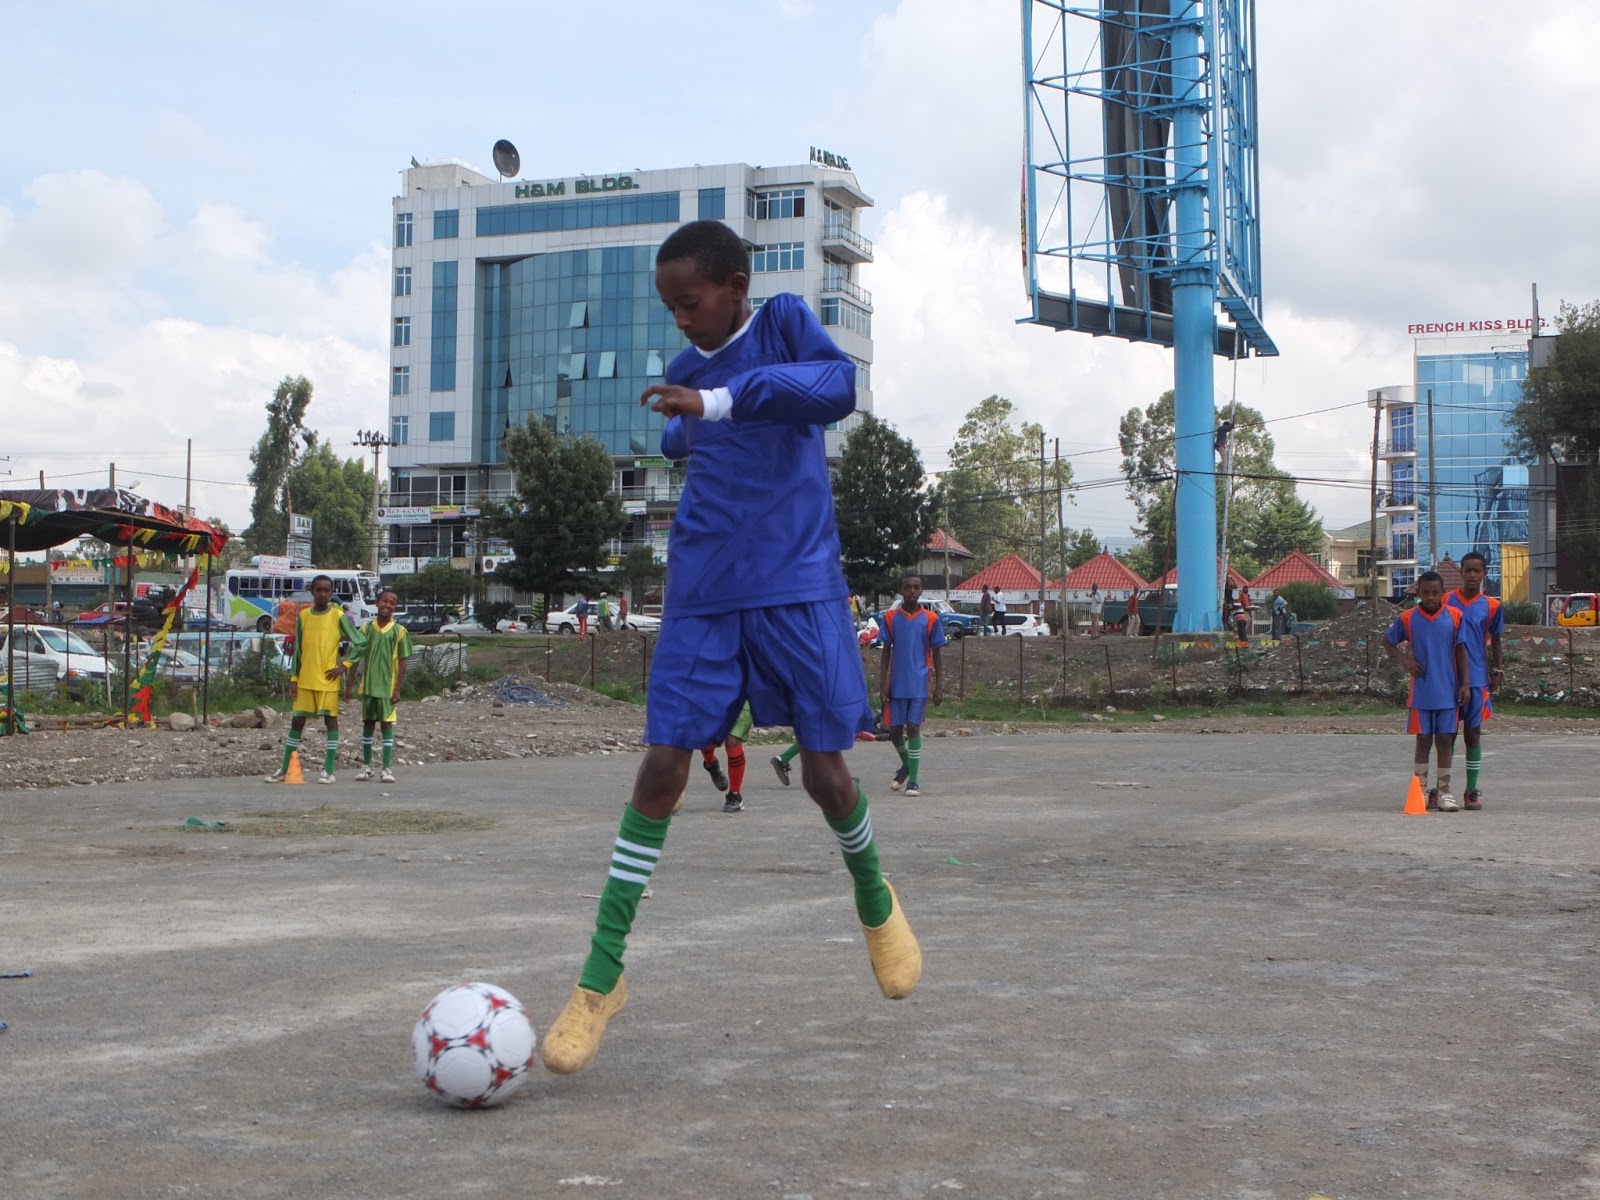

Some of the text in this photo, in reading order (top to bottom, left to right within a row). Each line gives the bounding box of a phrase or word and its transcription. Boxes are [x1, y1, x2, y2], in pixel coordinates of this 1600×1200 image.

[515, 176, 640, 198] H&M BLDG.
[1408, 318, 1550, 334] FRENCH KISS BLDG.
